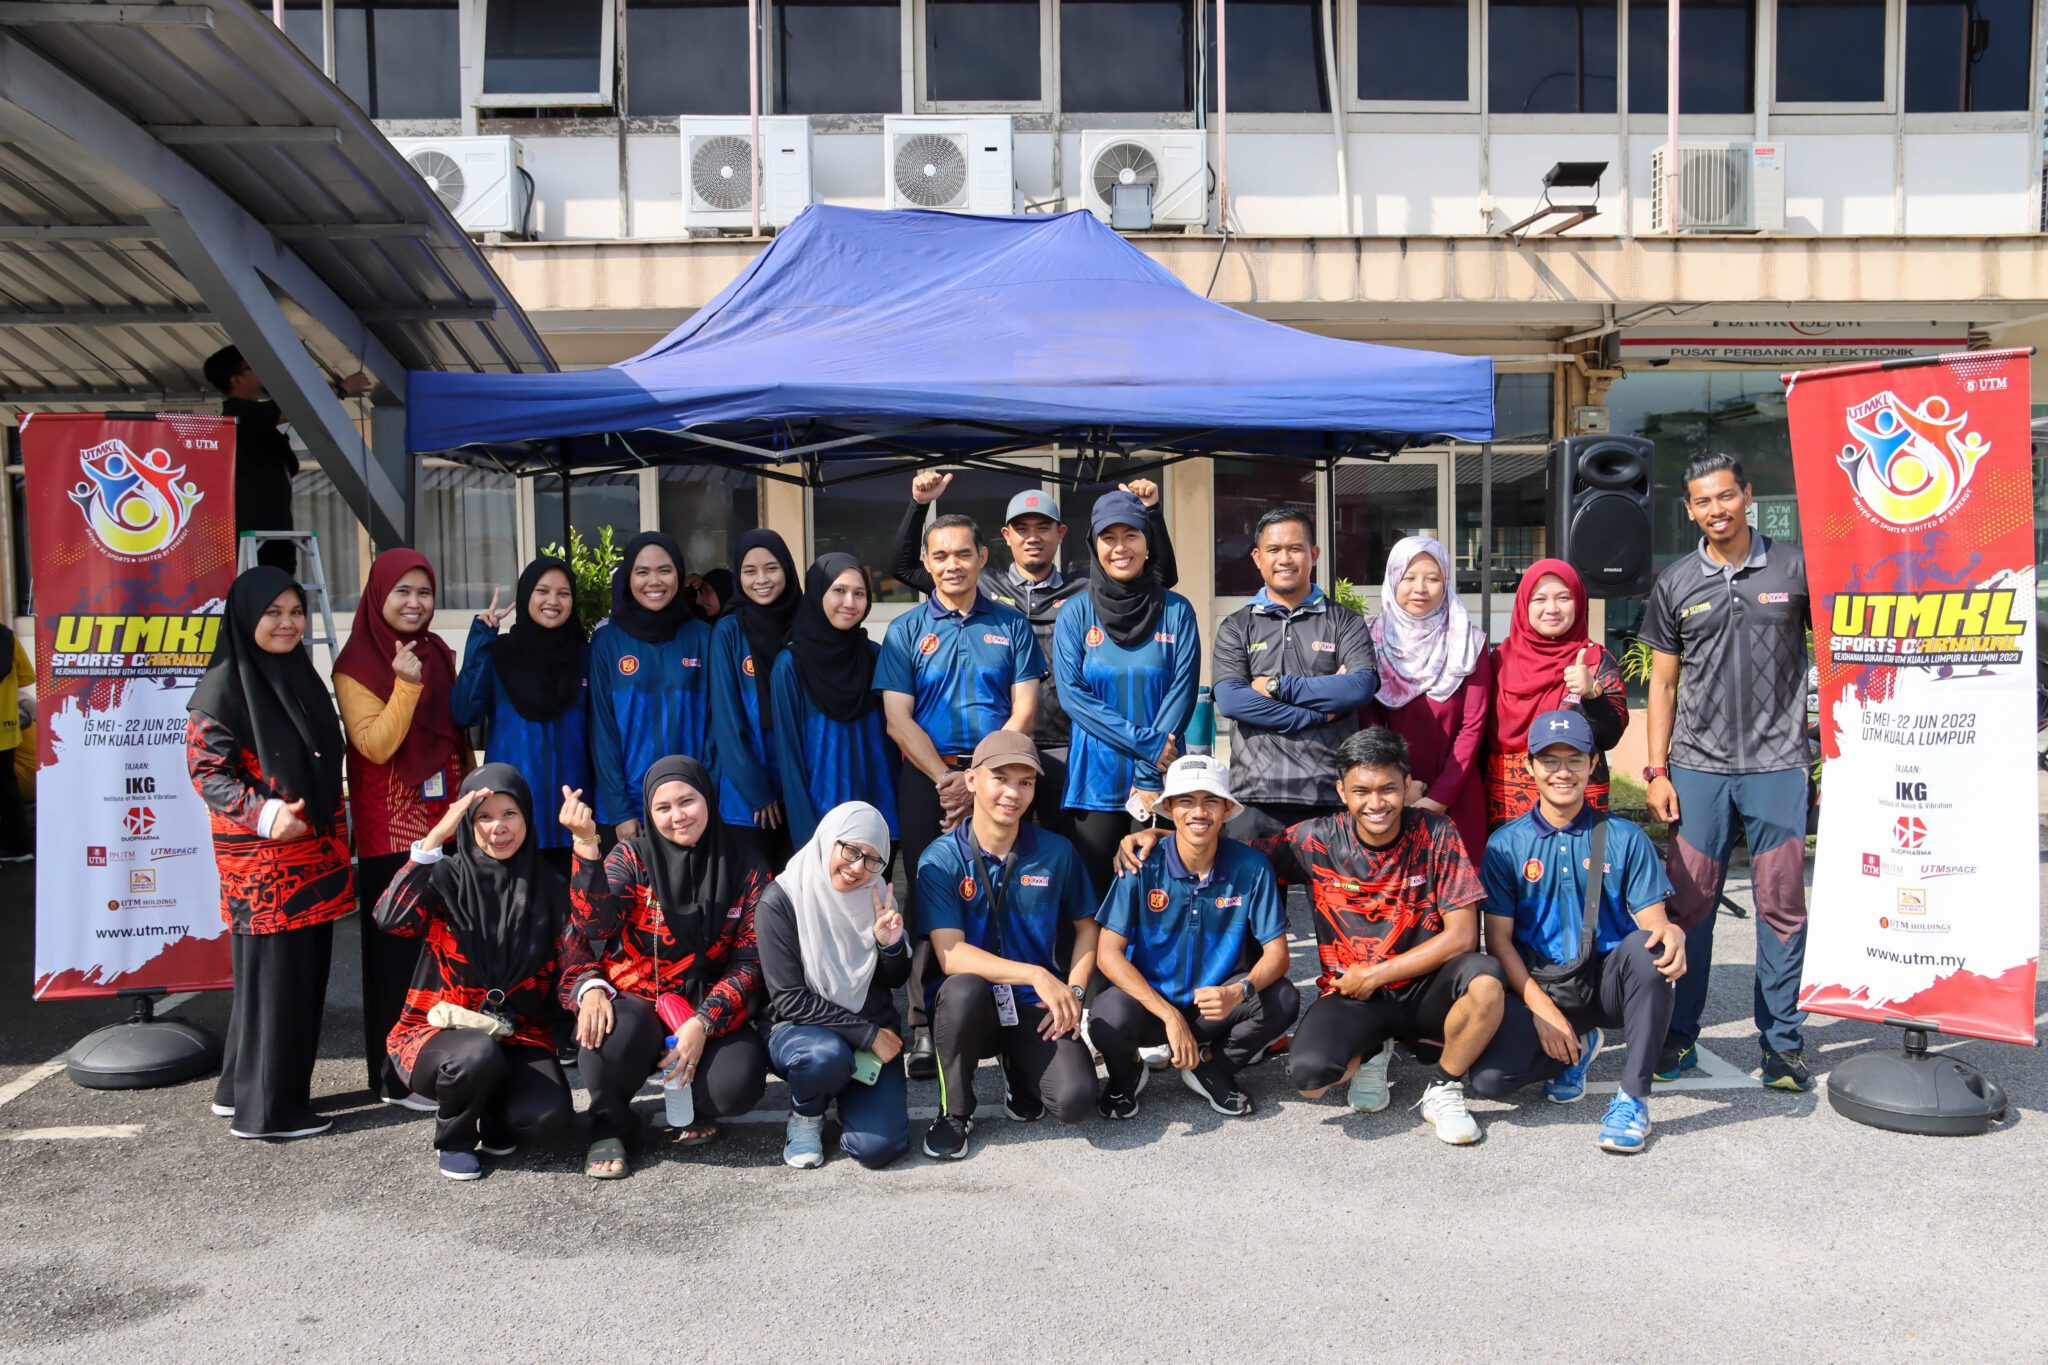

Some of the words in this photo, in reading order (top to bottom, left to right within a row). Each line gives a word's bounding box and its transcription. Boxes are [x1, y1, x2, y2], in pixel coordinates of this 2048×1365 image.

[1671, 348, 1718, 357] PUSAT
[1724, 348, 1817, 357] PERBANKAN
[1822, 347, 1914, 357] ELEKTRONIK
[1979, 377, 2008, 389] UTM
[1848, 393, 1890, 419] UTMKL
[82, 441, 119, 460] UTMKL
[195, 439, 219, 449] UTM
[1767, 505, 1791, 514] ATM
[1853, 496, 1870, 518] DRIVEN
[1870, 516, 1880, 527] BY
[1880, 522, 1900, 533] SPORTS
[1909, 519, 1937, 533] UNITED
[1938, 513, 1948, 524] BY
[1948, 488, 1972, 517] SYNERGY
[1767, 514, 1790, 529] 24
[1767, 529, 1790, 537] JAM
[107, 551, 130, 563] SPORTS
[138, 553, 162, 563] UNITED
[170, 529, 190, 553] SYNERGY
[1831, 591, 2025, 638] UTMKL
[1829, 636, 1897, 653] SPORTS
[1901, 636, 2020, 654] CARNIVAL
[51, 653, 124, 667] SPORTS
[131, 653, 213, 667] CARNIV
[1864, 654, 1884, 663] SUKAN
[1907, 655, 1930, 664] KUALA
[1930, 654, 1961, 663] LUMPUR
[1962, 654, 1967, 663] &
[1968, 653, 1998, 662] ALUMNI
[1999, 653, 2019, 662] 2023
[55, 667, 88, 676] KEJOHANAN
[89, 668, 107, 676] SUKAN
[107, 668, 121, 676] STAF
[122, 668, 136, 676] UTM
[137, 668, 157, 676] KUALA
[157, 668, 182, 676] LUMPUR
[84, 719, 94, 732] 15
[97, 719, 115, 732] MEI
[125, 719, 140, 732] 22
[142, 718, 164, 731] JUN
[166, 718, 188, 731] 202
[1862, 711, 1872, 725] 15
[1873, 712, 1890, 727] MEI
[1897, 714, 1910, 729] 22
[1912, 714, 1938, 729] JUN
[1941, 713, 1976, 729] 2023
[84, 734, 106, 746] UTM
[108, 733, 144, 746] KUALA
[147, 732, 187, 745] LUMPU
[1862, 727, 1882, 742] UTM
[1884, 729, 1915, 746] KUALA
[1918, 730, 1976, 746] LUMPUR
[125, 776, 155, 794] IKG
[1896, 781, 1927, 801] IKG
[1900, 802, 1916, 810] Noise
[150, 847, 198, 856] UTMSPACE
[1891, 848, 1932, 856] DUOPHARMA
[1863, 864, 1880, 875] UTM
[1920, 864, 1977, 874] UTMSPACE
[121, 899, 141, 907] UTM
[1889, 919, 1909, 929] UTM
[96, 925, 190, 938] www.utm.my
[1866, 946, 1966, 971] www.utm.my
